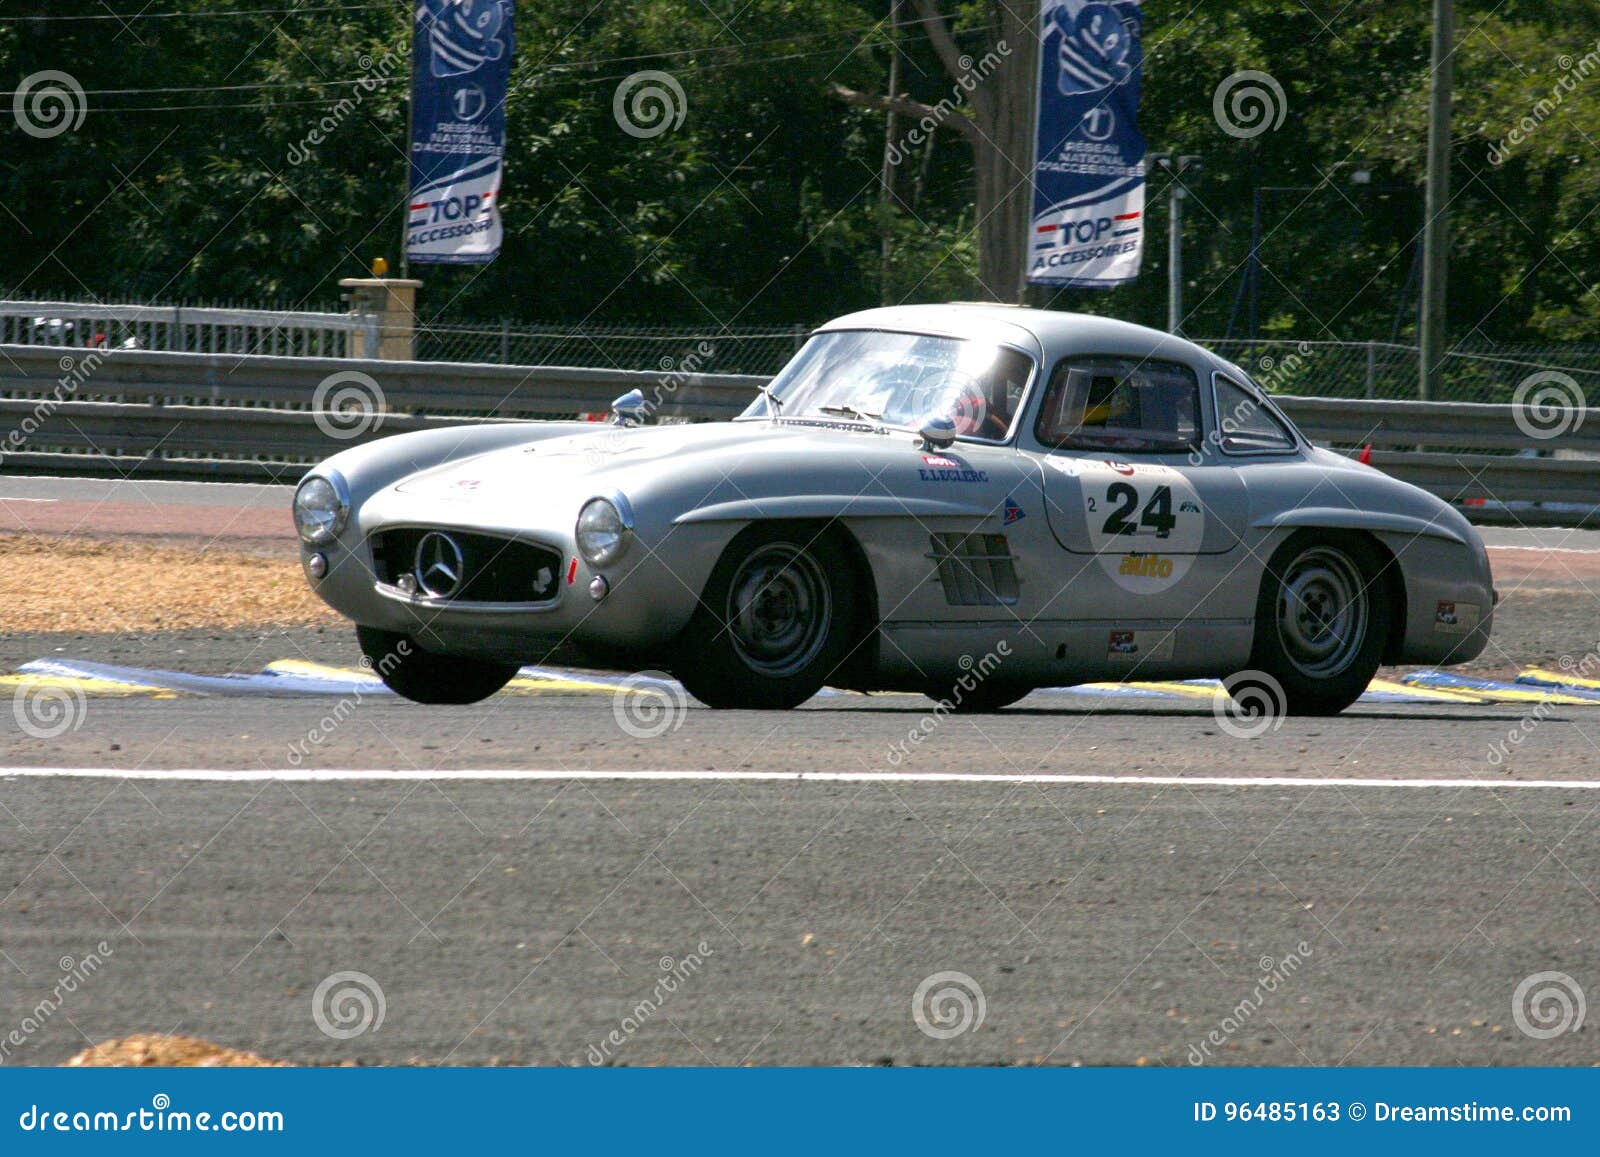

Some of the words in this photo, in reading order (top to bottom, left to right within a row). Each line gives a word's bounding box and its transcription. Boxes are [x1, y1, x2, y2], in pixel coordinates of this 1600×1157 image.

[430, 195, 480, 224] TOP
[1060, 217, 1112, 245] TOP
[1033, 240, 1138, 271] ACCESSOIRES
[1087, 496, 1097, 513] 2
[1102, 481, 1176, 539] 24
[1119, 554, 1173, 578] auto
